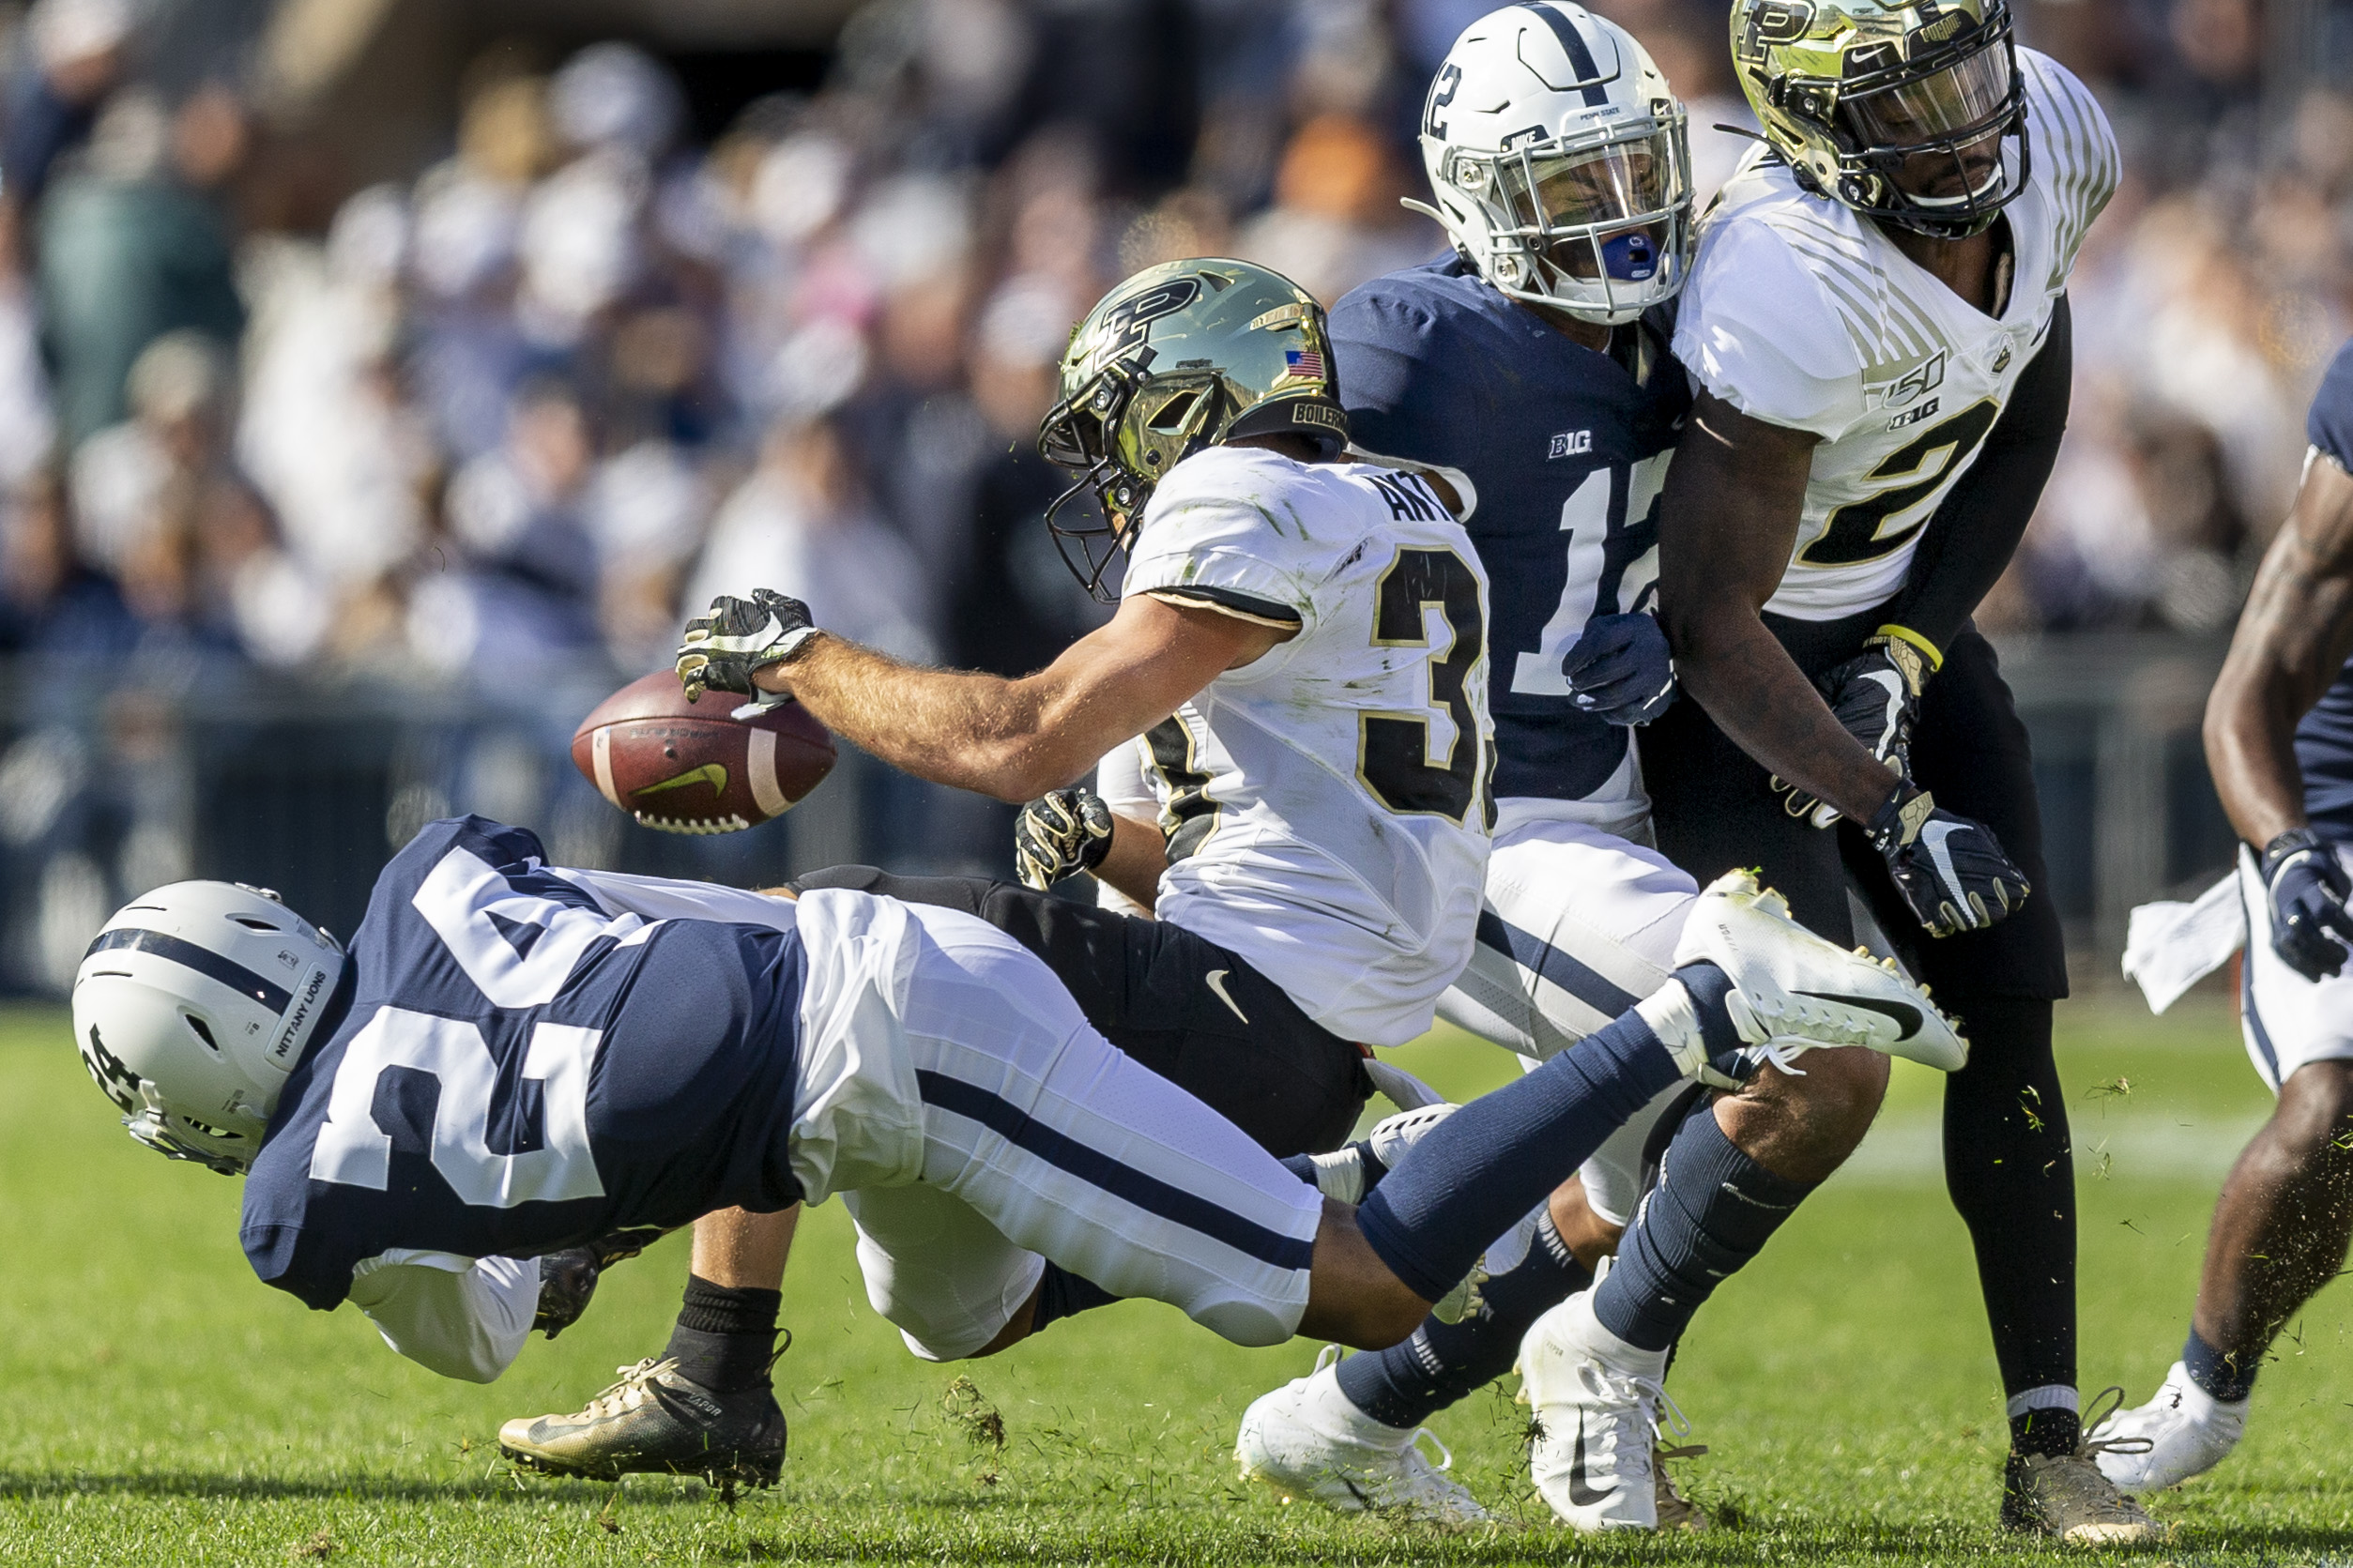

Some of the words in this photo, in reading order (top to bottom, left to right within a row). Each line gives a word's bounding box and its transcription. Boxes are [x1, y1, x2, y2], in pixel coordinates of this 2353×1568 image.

[1511, 130, 1536, 150] NIKE
[1580, 112, 1599, 121] PENN
[1600, 106, 1621, 116] STATE
[1793, 394, 2003, 569] 2
[275, 1002, 310, 1058] NITTANY
[305, 970, 327, 1005] LIONS
[309, 845, 667, 1208] 24
[689, 1393, 723, 1417] VAPOR
